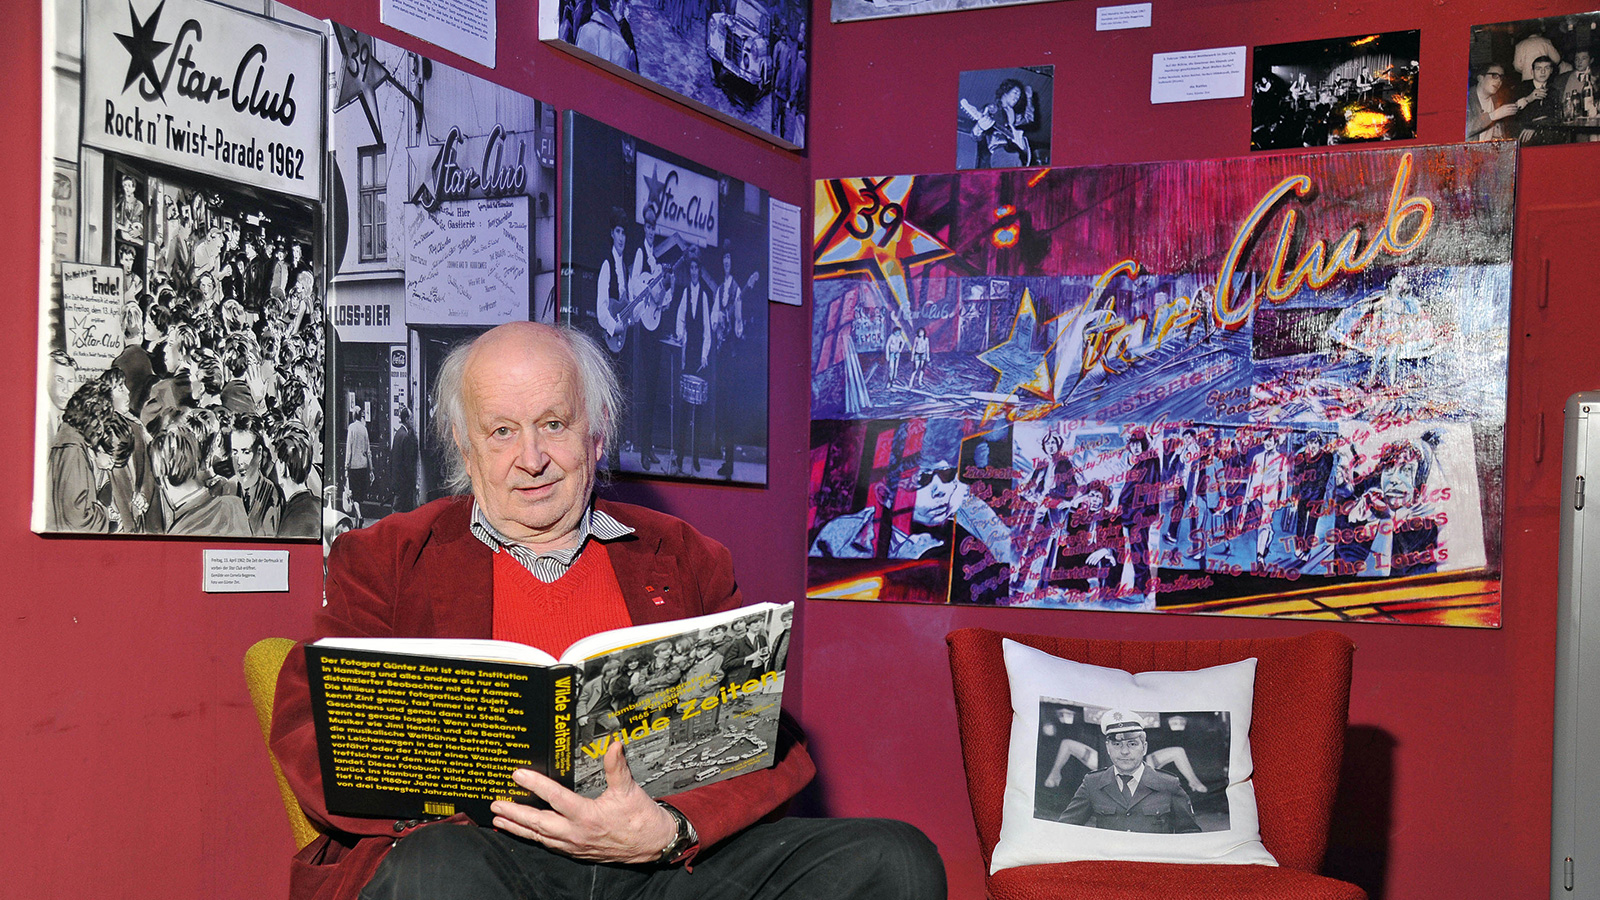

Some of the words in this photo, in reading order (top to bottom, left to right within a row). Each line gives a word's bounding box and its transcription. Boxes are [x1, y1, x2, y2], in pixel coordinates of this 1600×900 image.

[347, 33, 370, 82] 39
[139, 18, 296, 126] Star-Club
[104, 99, 144, 142] Rock
[165, 114, 264, 172] Twist-Parade
[267, 141, 305, 181] 1962
[457, 207, 471, 218] Hier
[846, 187, 904, 249] 39
[92, 276, 120, 296] Ende!
[328, 304, 391, 327] LOSS-BIER
[1324, 511, 1449, 546] Searchers
[1204, 558, 1243, 577] The
[1249, 561, 1302, 582] Who
[1320, 558, 1367, 578] The
[1373, 541, 1449, 570] Lords
[333, 667, 376, 677] Hamburg
[340, 658, 381, 668] Fotograf
[383, 662, 416, 671] Günter
[478, 670, 528, 680] Institution
[323, 675, 384, 685] distanzierter
[387, 680, 443, 690] Beobachter
[483, 689, 522, 698] Kamera.
[343, 685, 375, 693] Milieus
[409, 690, 478, 702] fotografischen
[481, 697, 508, 705] Sujets
[555, 676, 571, 712] Wilde
[326, 700, 384, 710] Geschehens
[438, 710, 462, 718] dann
[480, 714, 507, 722] Stelle,
[377, 697, 409, 705] genau,
[433, 701, 461, 709] immer
[404, 714, 440, 724] losgeht:
[471, 723, 527, 732] unbekannte
[580, 715, 671, 760] Wilde
[680, 669, 778, 721] Zeiten
[329, 717, 364, 725] Musiker
[406, 723, 441, 732] Hendrix
[481, 730, 515, 739] Beatles
[347, 728, 405, 737] musikalische
[407, 732, 457, 742] Weltbühne
[460, 737, 503, 746] betreten,
[555, 713, 571, 752] Zeiten
[348, 735, 414, 746] Leichenwagen
[446, 744, 508, 755] Herbertstraße
[333, 750, 381, 758] treffsicher
[476, 762, 518, 771] Polizisten
[334, 757, 365, 765] landet.
[368, 760, 396, 768] Dieses
[398, 763, 440, 772] Fotobuch
[487, 771, 513, 779] Betra
[471, 754, 532, 765] Wassereimers
[383, 770, 423, 779] Hamburg
[475, 778, 504, 786] 1960er
[414, 780, 438, 789] Jahre
[376, 784, 420, 793] bewegten
[423, 788, 479, 798] Jahrzehnten
[496, 794, 514, 803] Bild.
